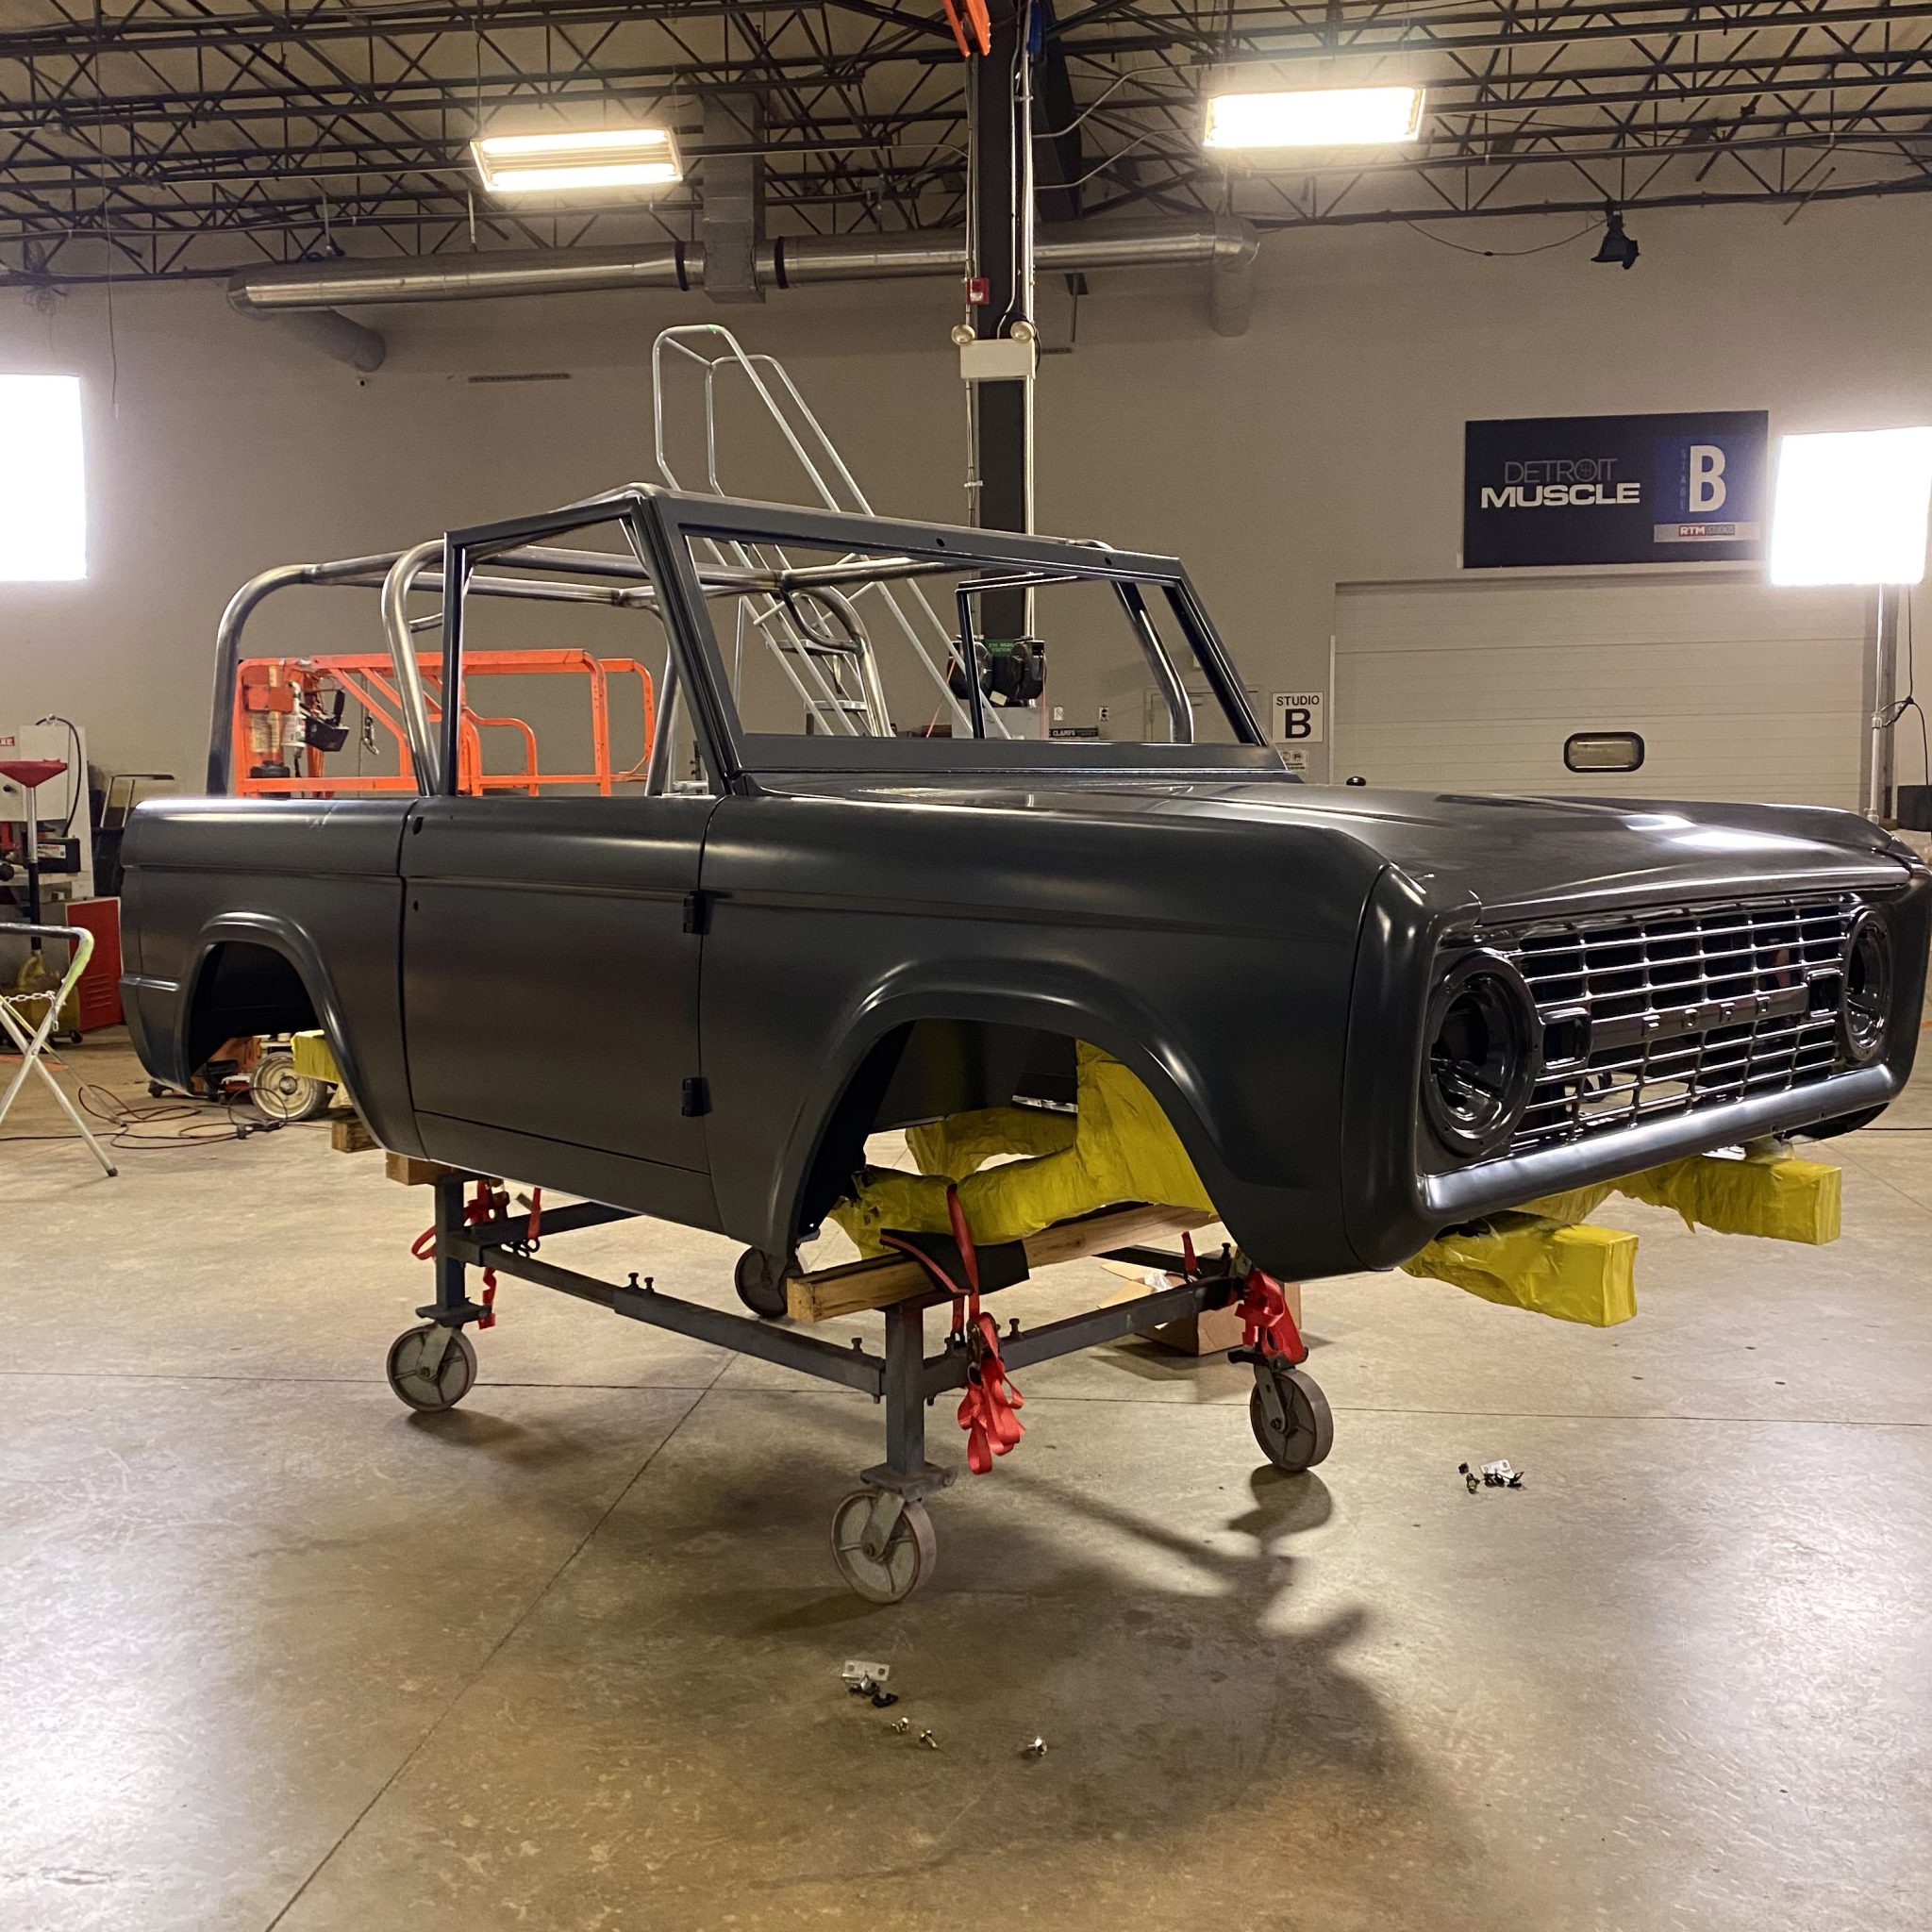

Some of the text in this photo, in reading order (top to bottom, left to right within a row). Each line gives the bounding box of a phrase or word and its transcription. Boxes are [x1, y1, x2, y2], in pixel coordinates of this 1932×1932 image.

[1505, 458, 1618, 484] DETROIT
[1689, 445, 1726, 512] B
[1480, 482, 1641, 508] MUSCLE
[1679, 525, 1706, 535] RTM
[1275, 695, 1320, 706] STUDIO
[1285, 708, 1311, 739] B
[1642, 996, 1771, 1036] FORD
